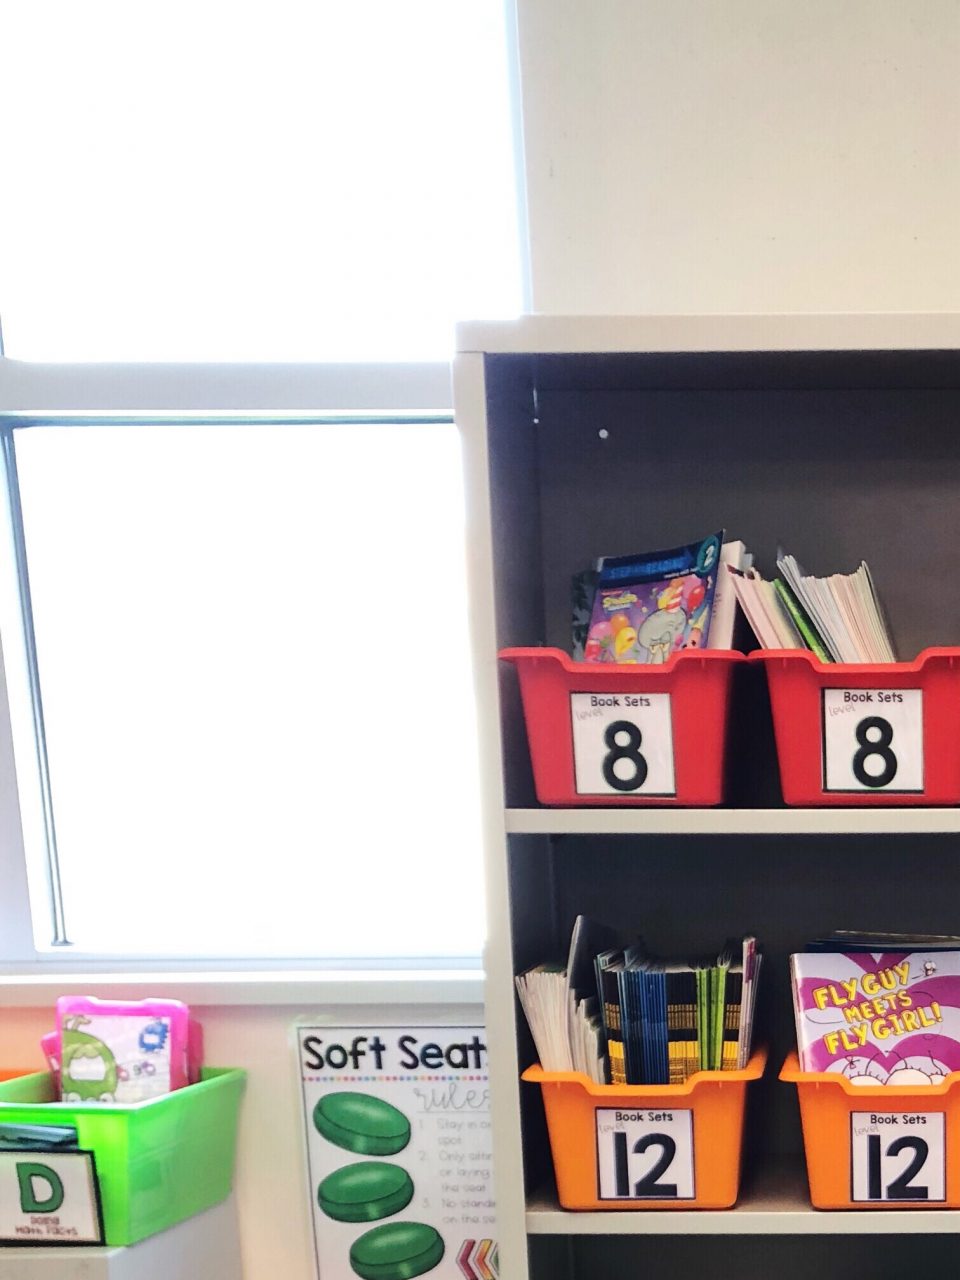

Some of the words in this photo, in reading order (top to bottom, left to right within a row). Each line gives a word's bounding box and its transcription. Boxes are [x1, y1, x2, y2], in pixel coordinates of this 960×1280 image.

[703, 545, 715, 565] 2
[590, 696, 620, 707] Book
[624, 696, 651, 707] Sets
[843, 692, 873, 703] Book
[877, 691, 903, 703] Sets
[602, 720, 648, 791] 8
[852, 716, 897, 788] 8
[812, 977, 858, 1011] FLY
[861, 961, 911, 995] GUY
[842, 989, 912, 1024] MEETS
[823, 1022, 868, 1055] FLY
[871, 1001, 943, 1040] GIRL!
[303, 1035, 386, 1070] Soft
[398, 1035, 488, 1070] Seat
[615, 1111, 644, 1122] Book
[648, 1111, 674, 1122] Sets
[870, 1114, 899, 1125] Book
[902, 1114, 927, 1125] Sets
[612, 1132, 678, 1197] 12
[866, 1134, 929, 1199] 12
[16, 1162, 64, 1213] D
